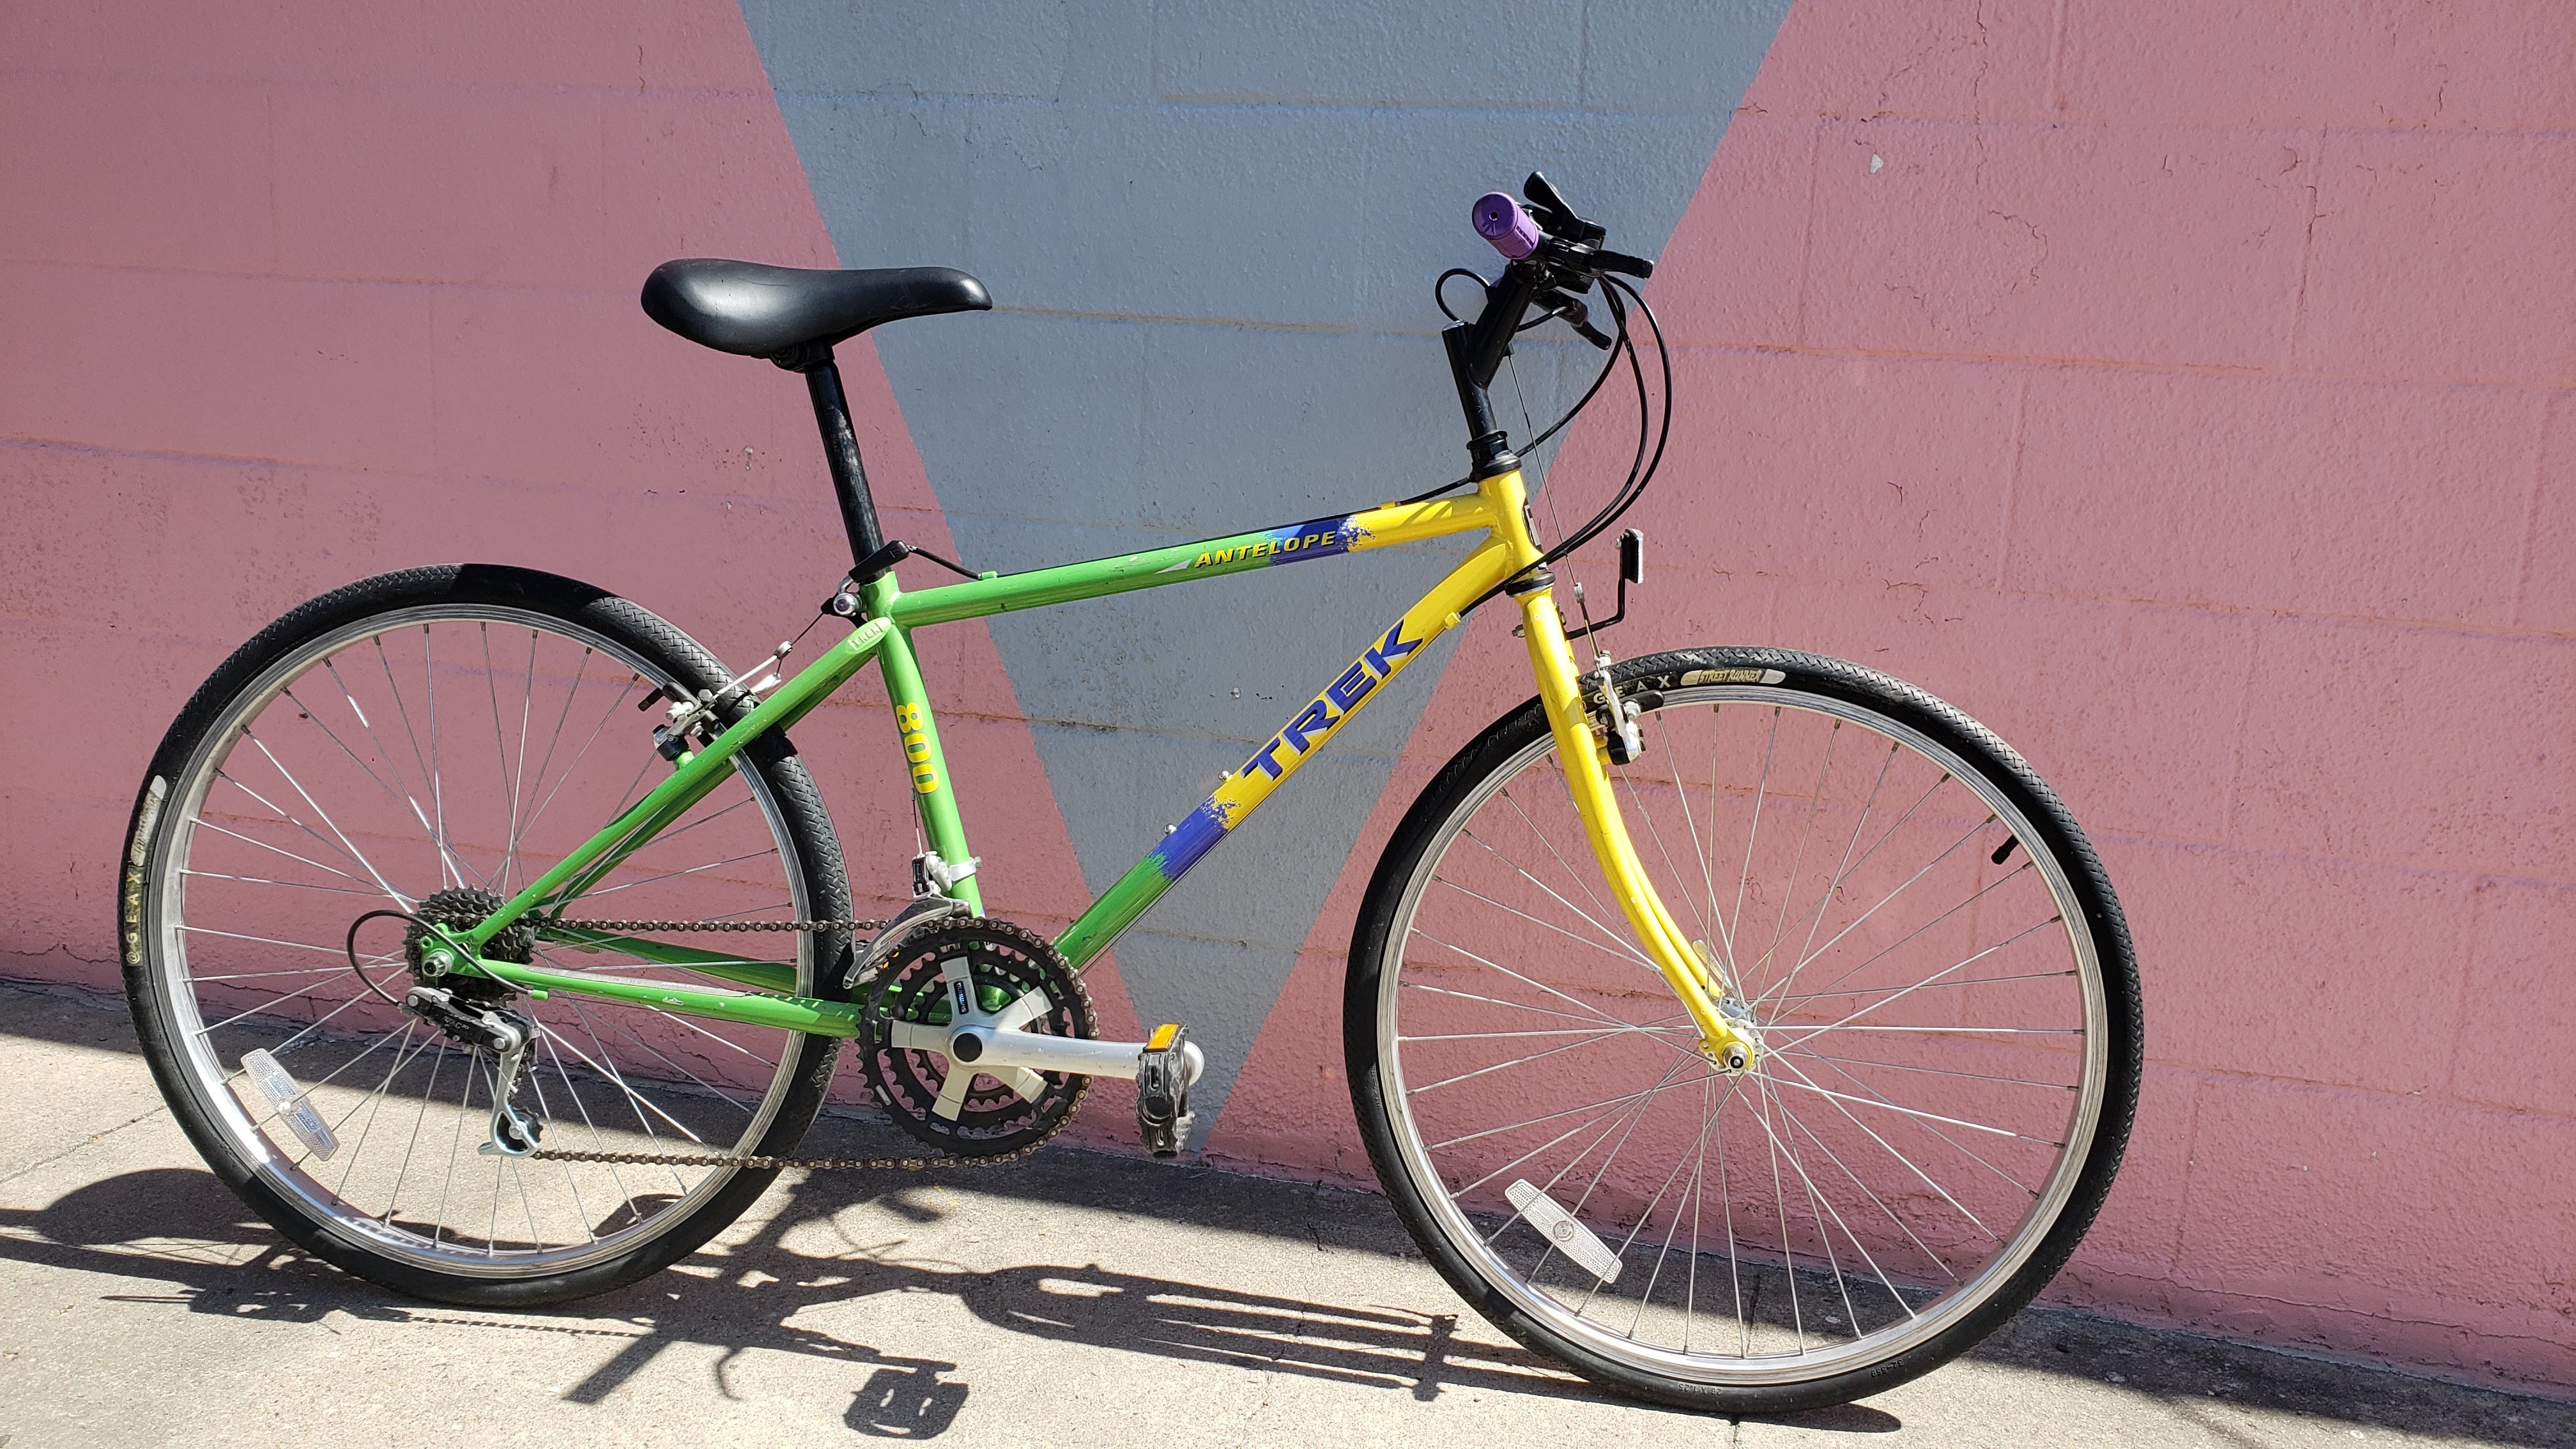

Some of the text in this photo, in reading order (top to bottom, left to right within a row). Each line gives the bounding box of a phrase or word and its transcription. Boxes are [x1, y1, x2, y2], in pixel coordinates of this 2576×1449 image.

[1193, 530, 1336, 568] ANTELOPE
[1240, 619, 1424, 781] TREK
[1699, 668, 1762, 684] STREET RUNNER
[896, 702, 940, 794] 800
[126, 871, 142, 942] GEAX
